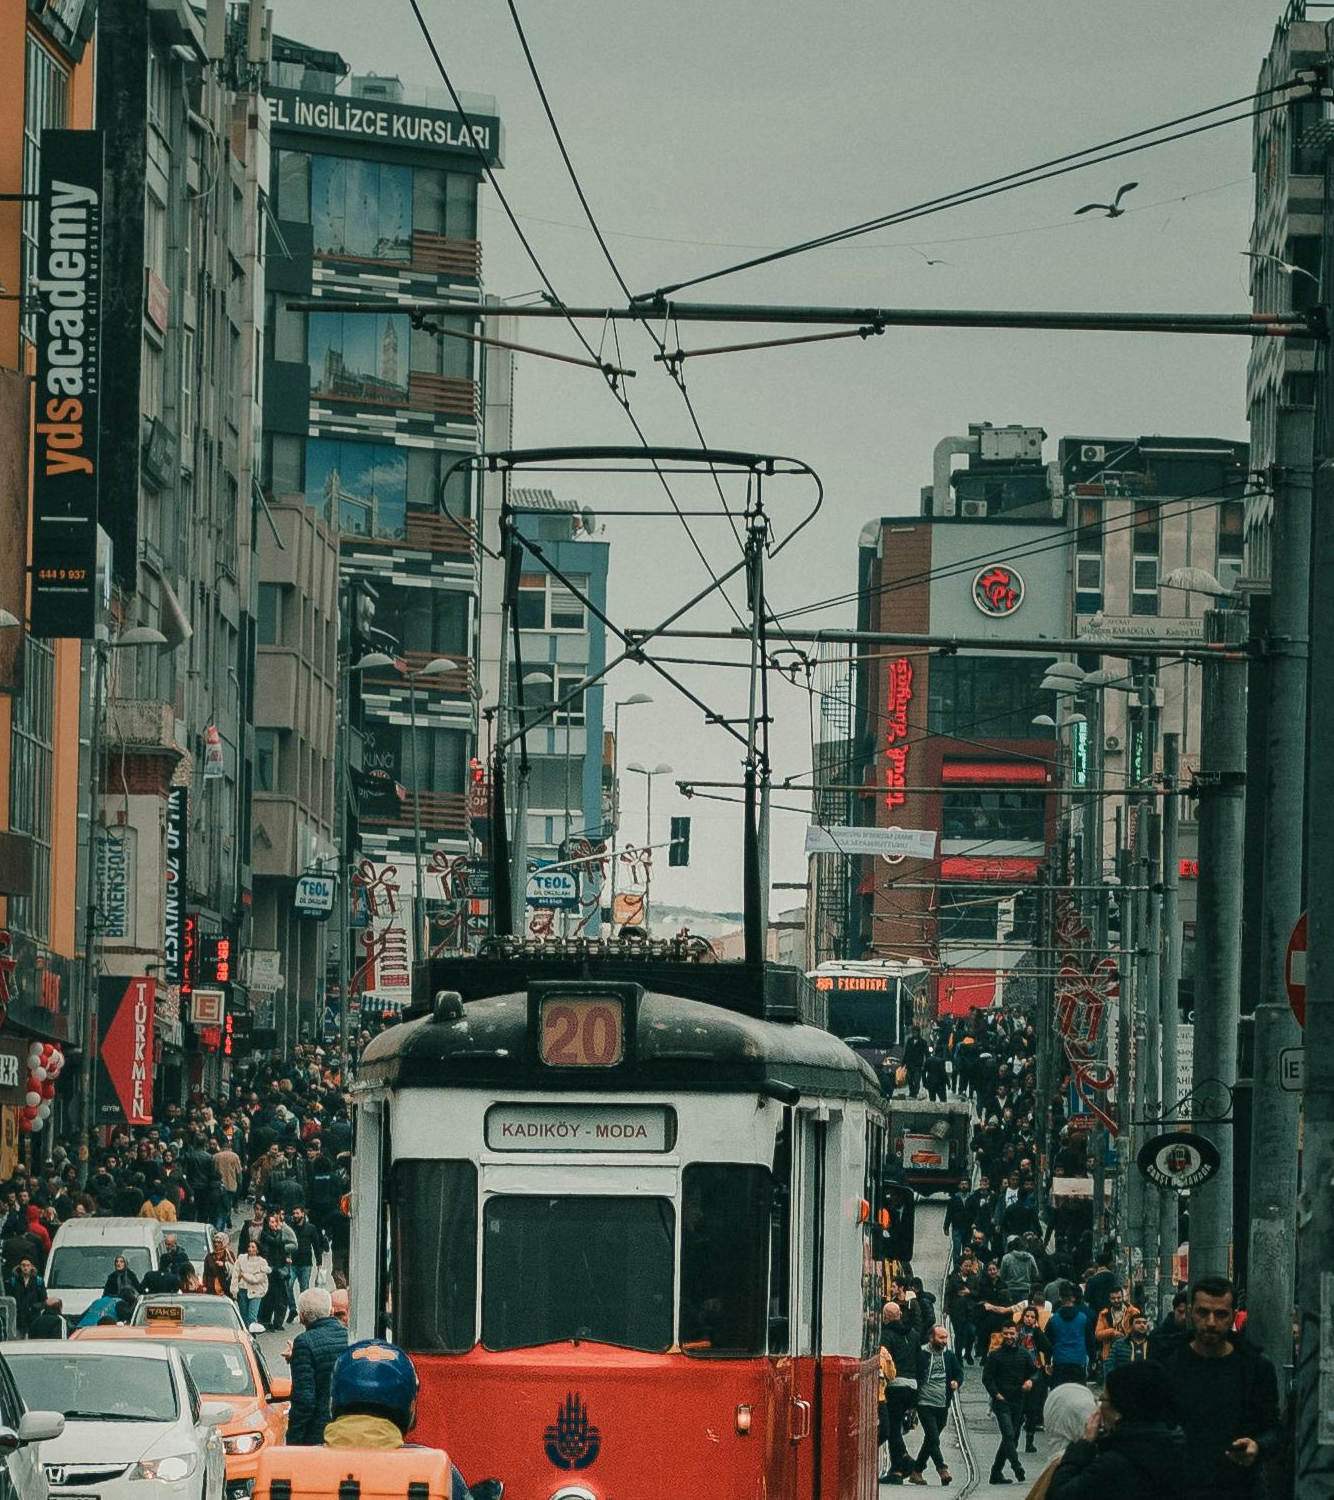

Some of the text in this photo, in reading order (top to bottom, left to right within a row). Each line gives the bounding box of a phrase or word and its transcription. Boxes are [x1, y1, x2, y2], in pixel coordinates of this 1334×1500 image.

[295, 96, 388, 136] İNGİLİZCE
[392, 114, 490, 150] KURSLARI
[36, 179, 98, 476] ydsacademy
[107, 837, 125, 937] BIRKENSTOCK
[300, 880, 329, 897] TEOL
[533, 875, 571, 889] TEOL
[131, 983, 147, 1118] TÜRKMEN
[546, 1005, 617, 1065] 20
[502, 1121, 581, 1138] KADIKÖY
[596, 1124, 647, 1138] MODA
